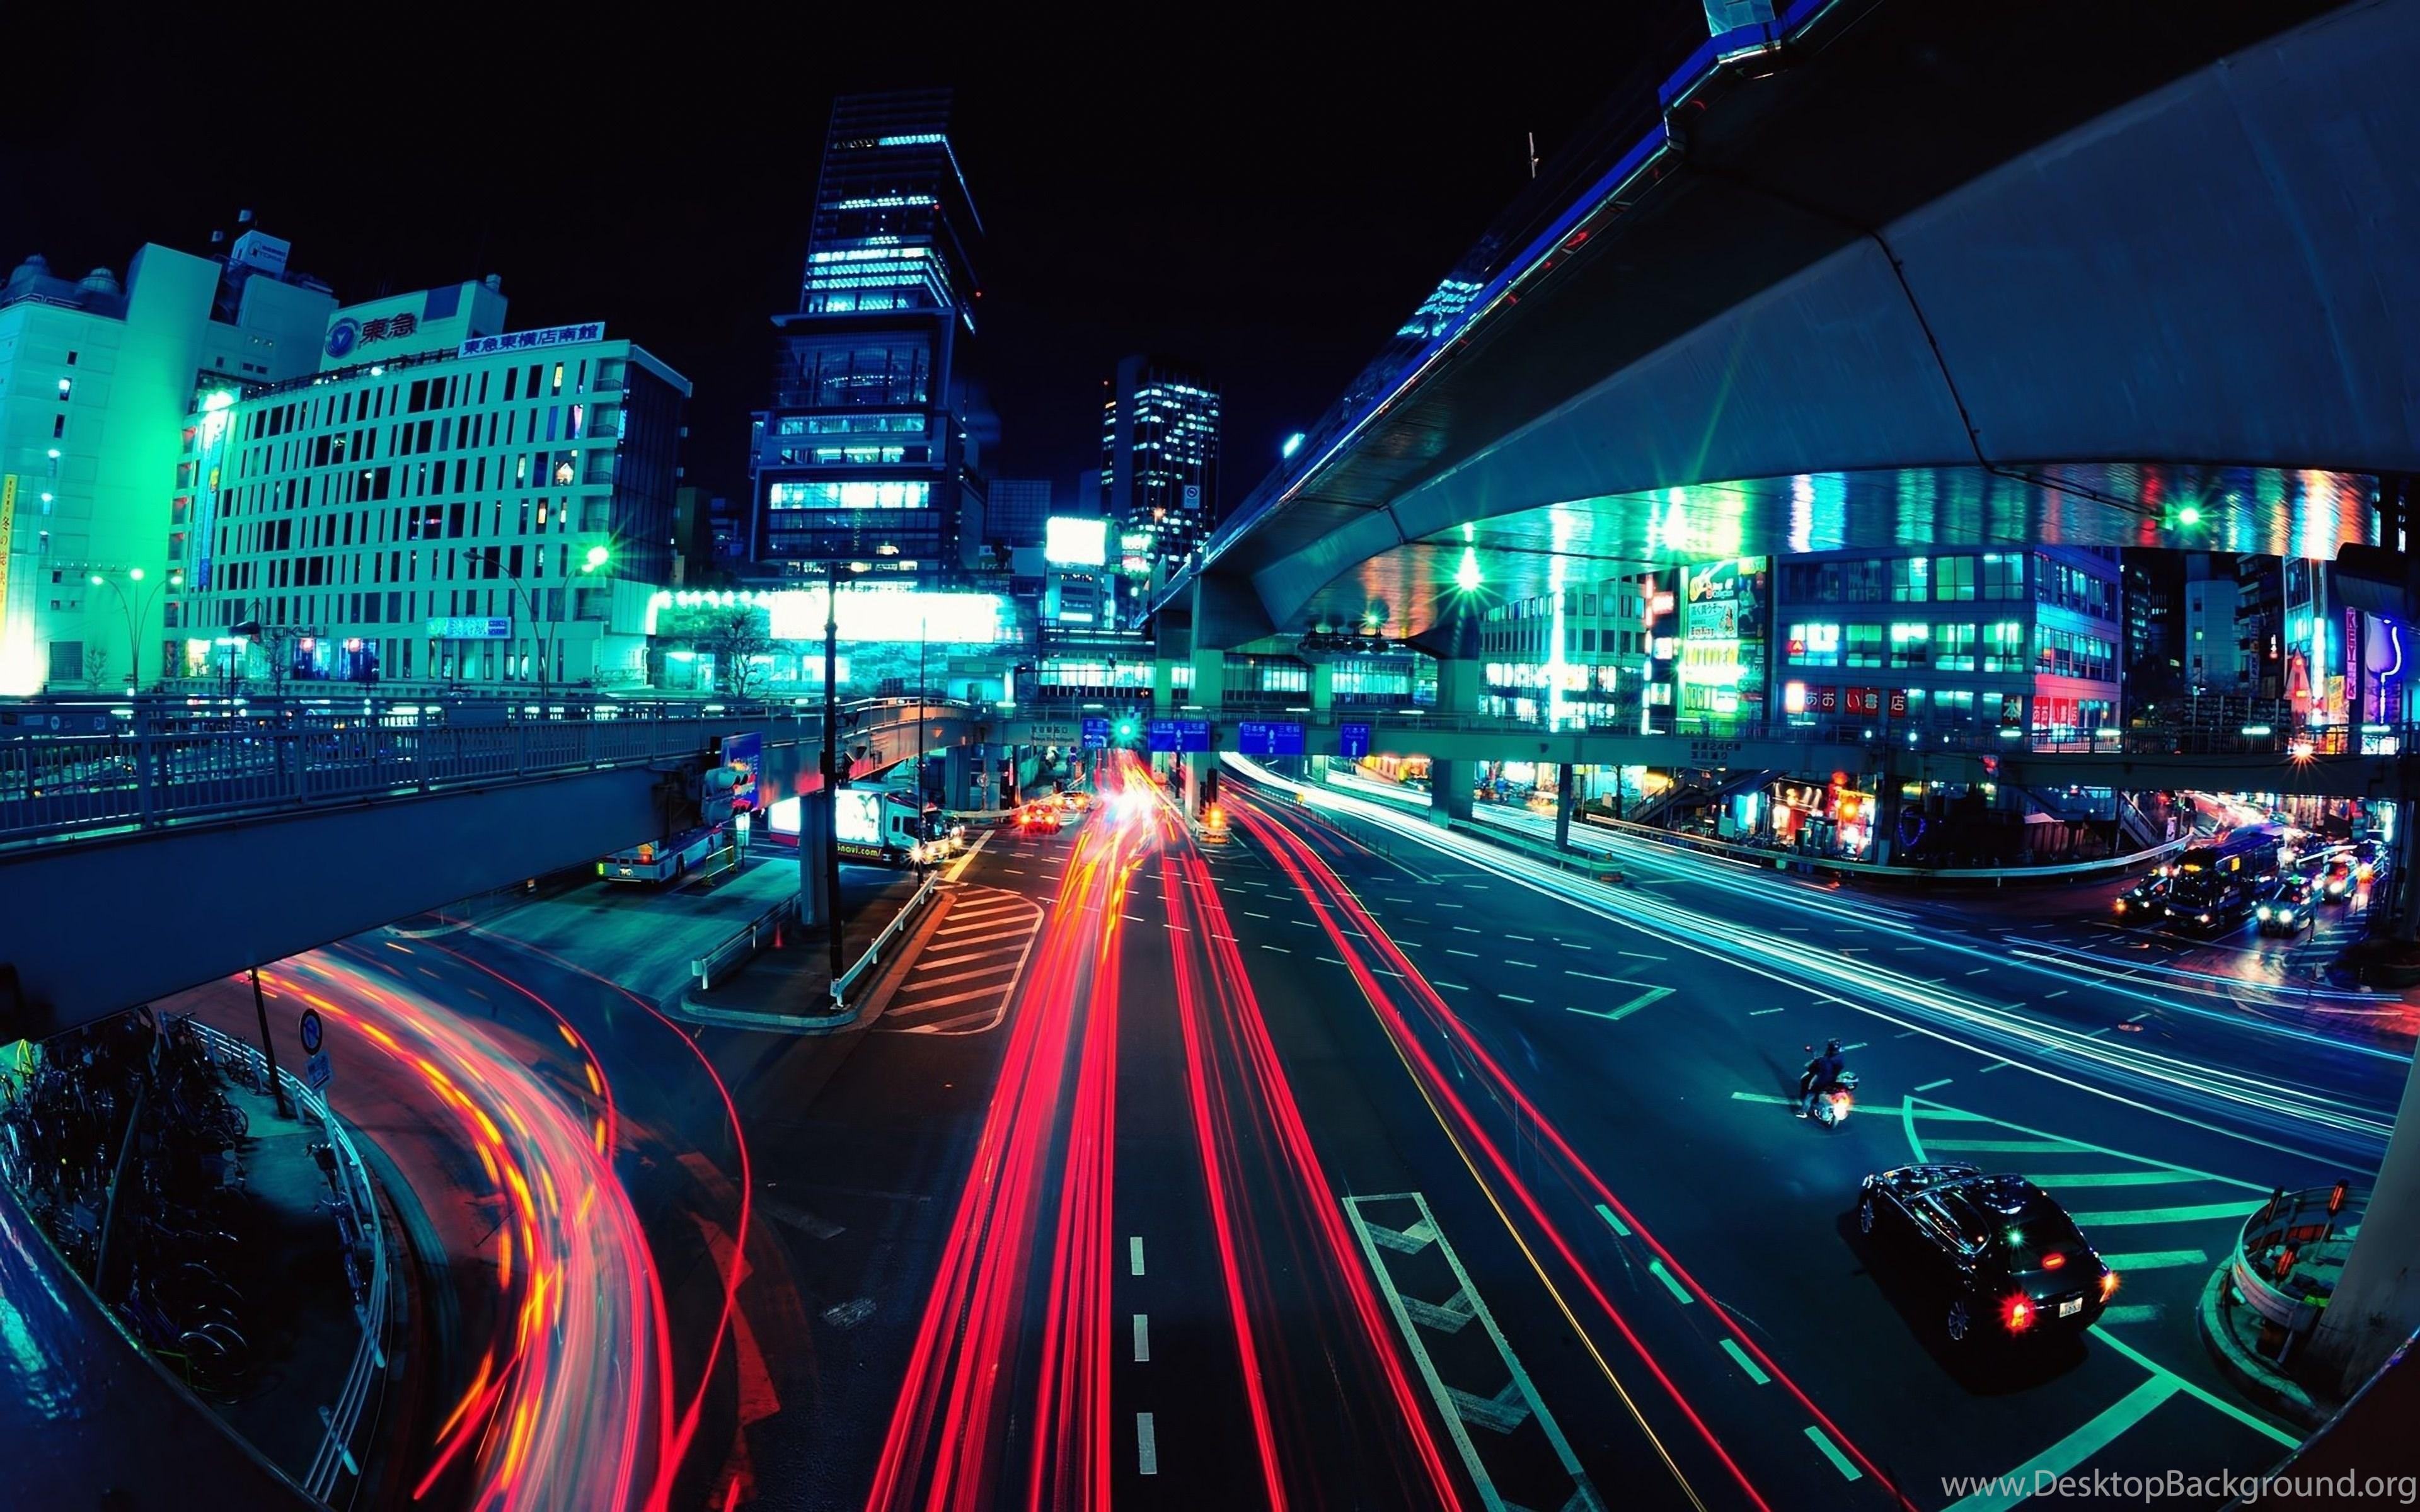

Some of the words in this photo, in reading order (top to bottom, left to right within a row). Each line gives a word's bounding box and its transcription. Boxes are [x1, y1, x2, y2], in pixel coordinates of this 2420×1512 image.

[360, 312, 417, 345] 東急
[463, 324, 599, 354] 東急東横店南館
[1806, 692, 1904, 711] あおい書店
